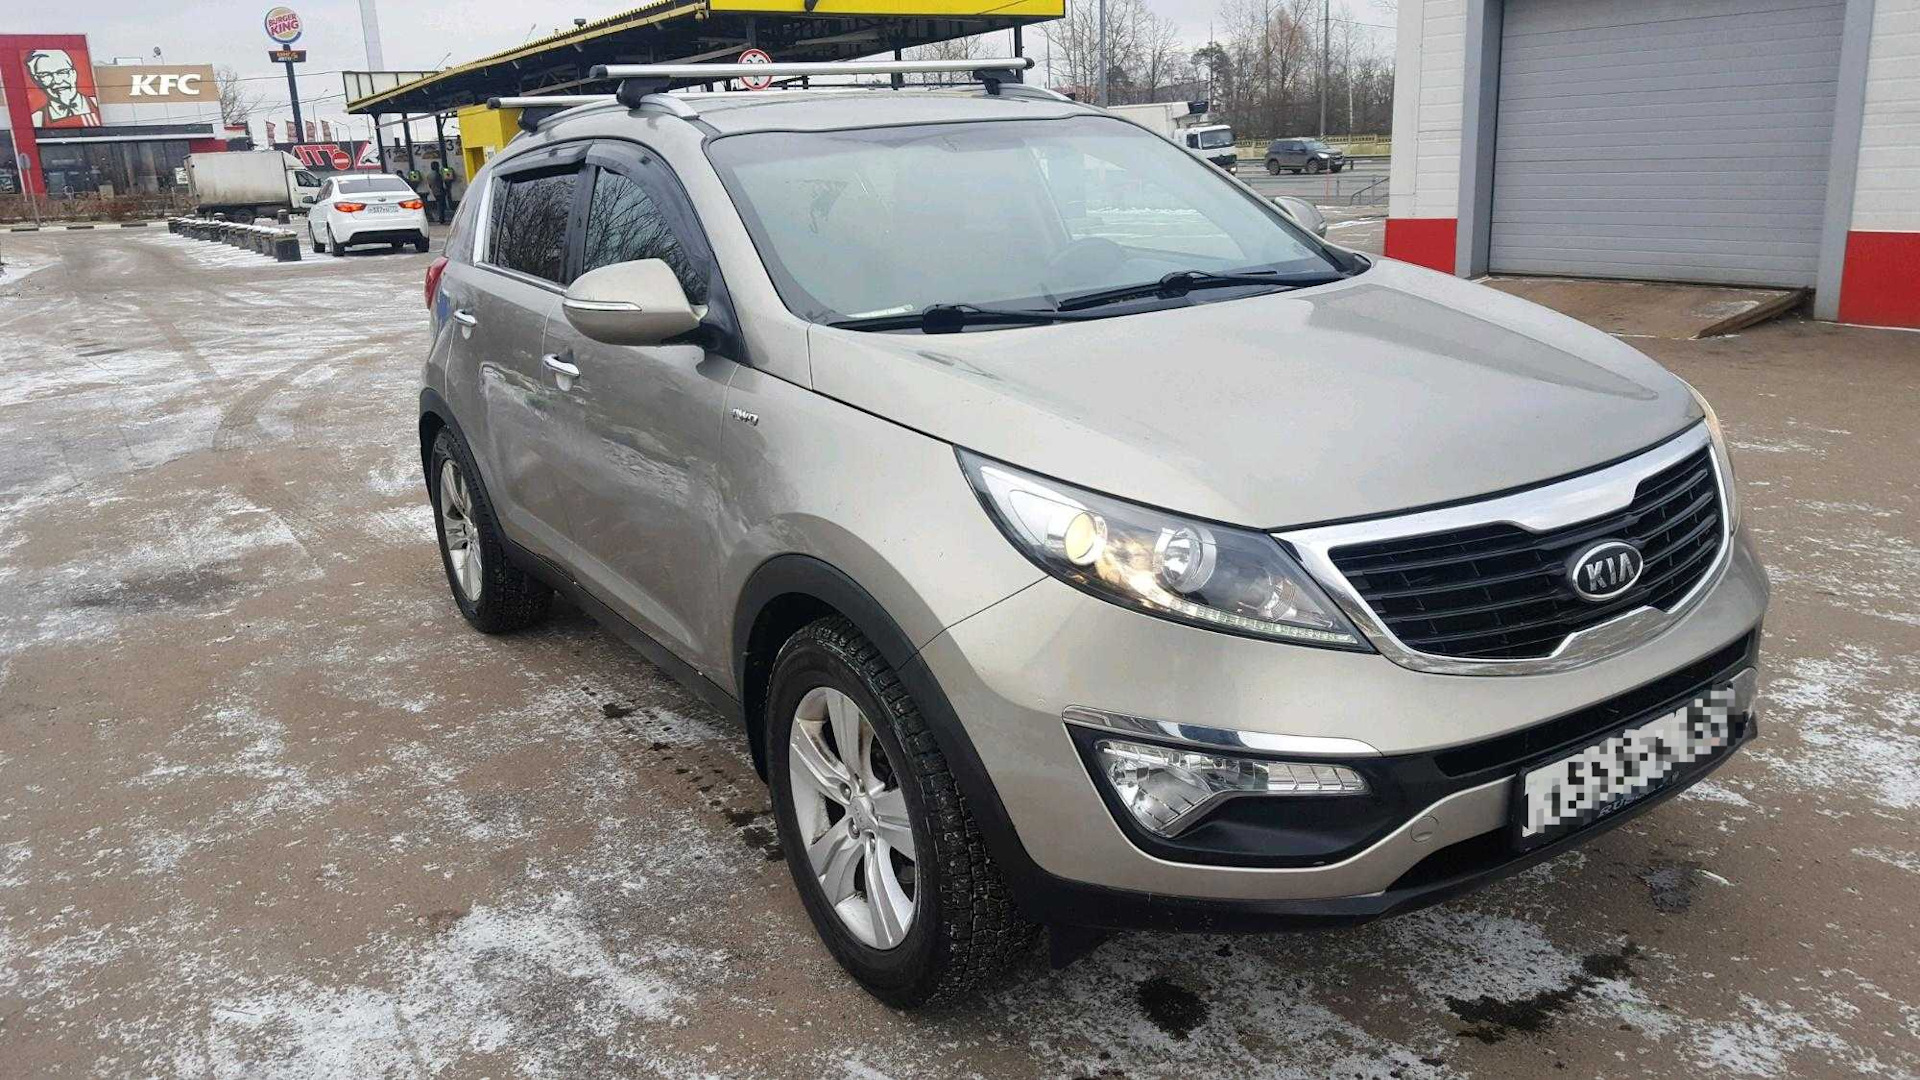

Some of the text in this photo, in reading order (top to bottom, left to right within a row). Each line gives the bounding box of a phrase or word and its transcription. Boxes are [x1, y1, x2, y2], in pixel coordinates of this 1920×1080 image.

[268, 13, 297, 27] BURGER
[270, 20, 300, 36] KING
[129, 73, 201, 96] KFC
[413, 144, 422, 156] 2
[446, 139, 455, 152] 3
[1585, 552, 1636, 592] KIA
